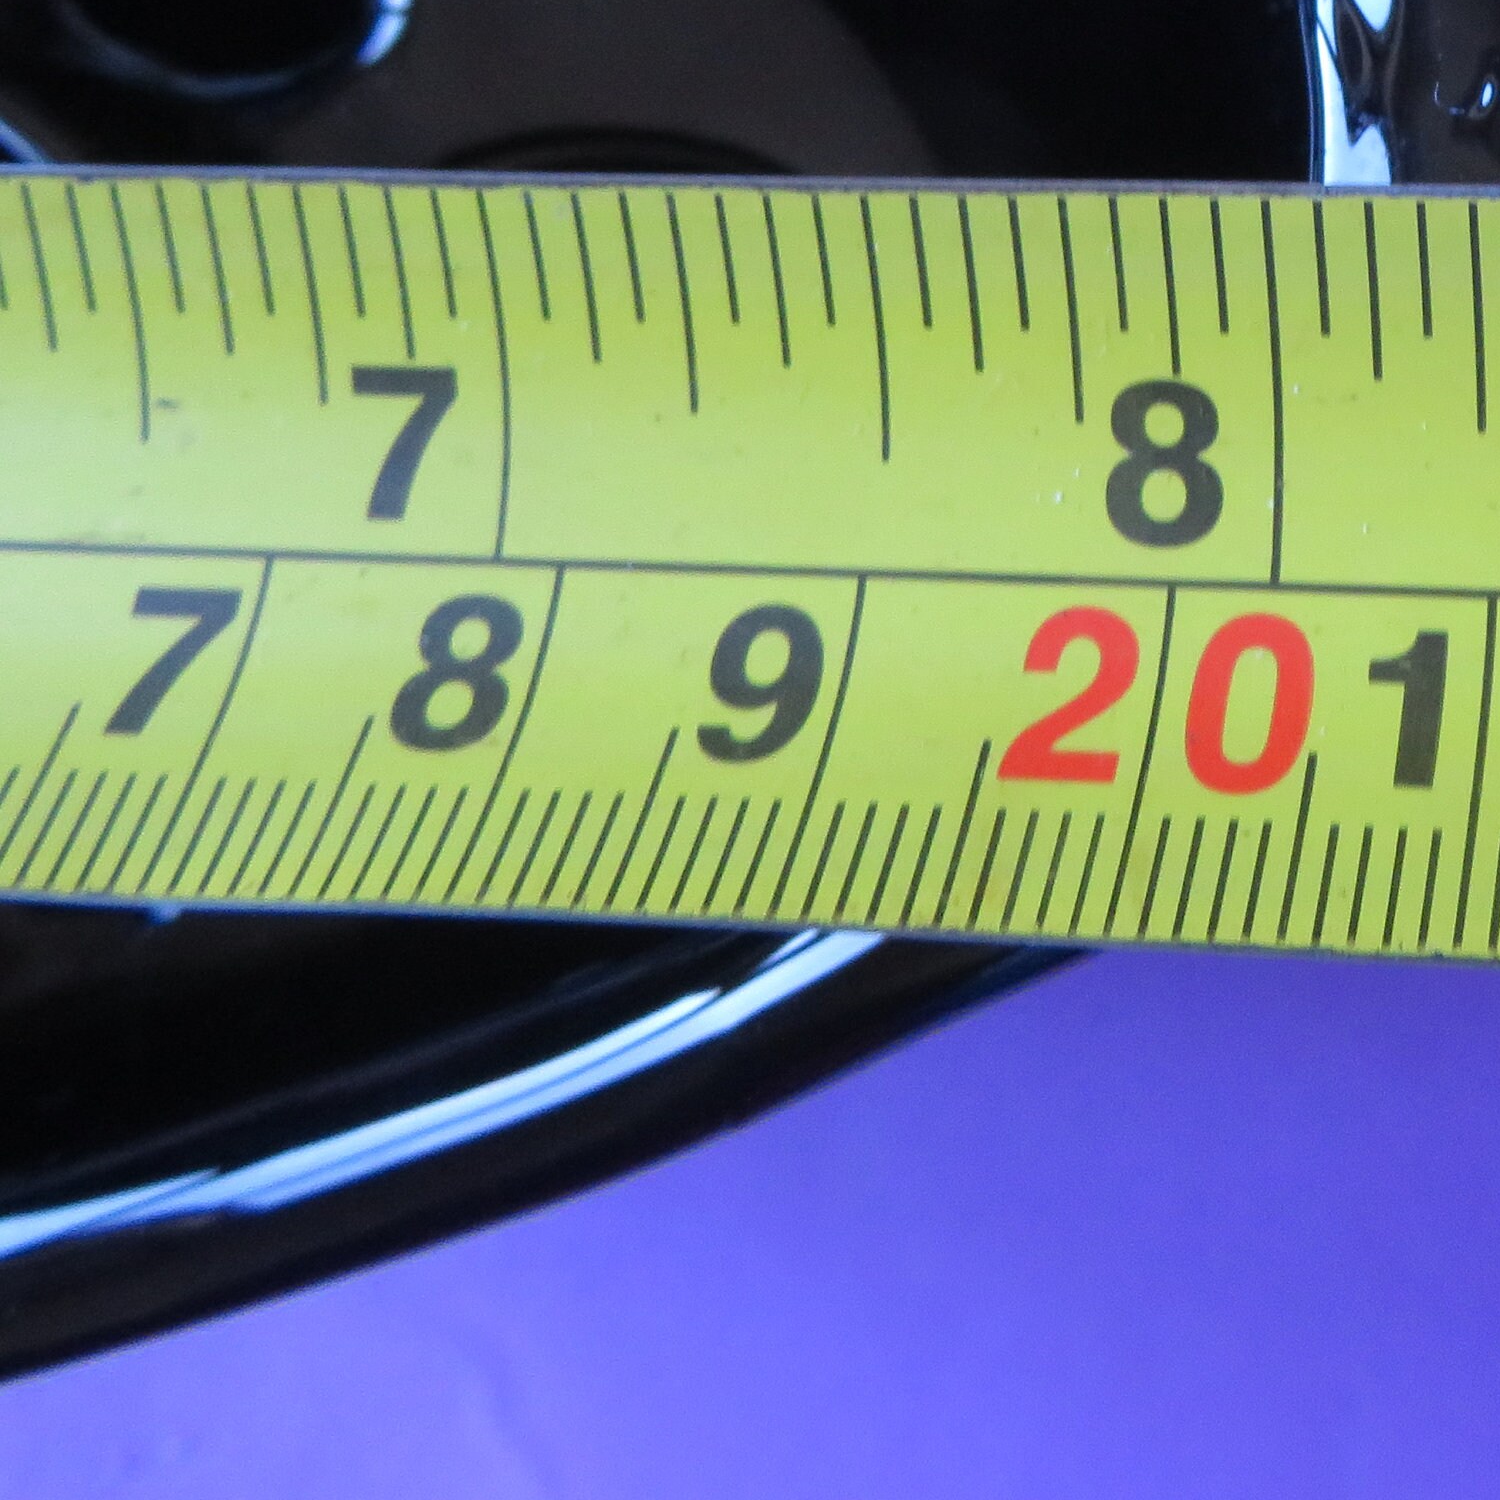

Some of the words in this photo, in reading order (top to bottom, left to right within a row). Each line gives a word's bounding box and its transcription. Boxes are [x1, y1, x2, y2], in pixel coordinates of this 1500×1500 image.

[352, 365, 458, 519] 7
[1105, 380, 1224, 548] 8
[103, 587, 242, 736] 7
[388, 594, 524, 752] 8
[695, 604, 825, 764] 9
[997, 606, 1314, 795] 20
[1367, 630, 1449, 789] 1
